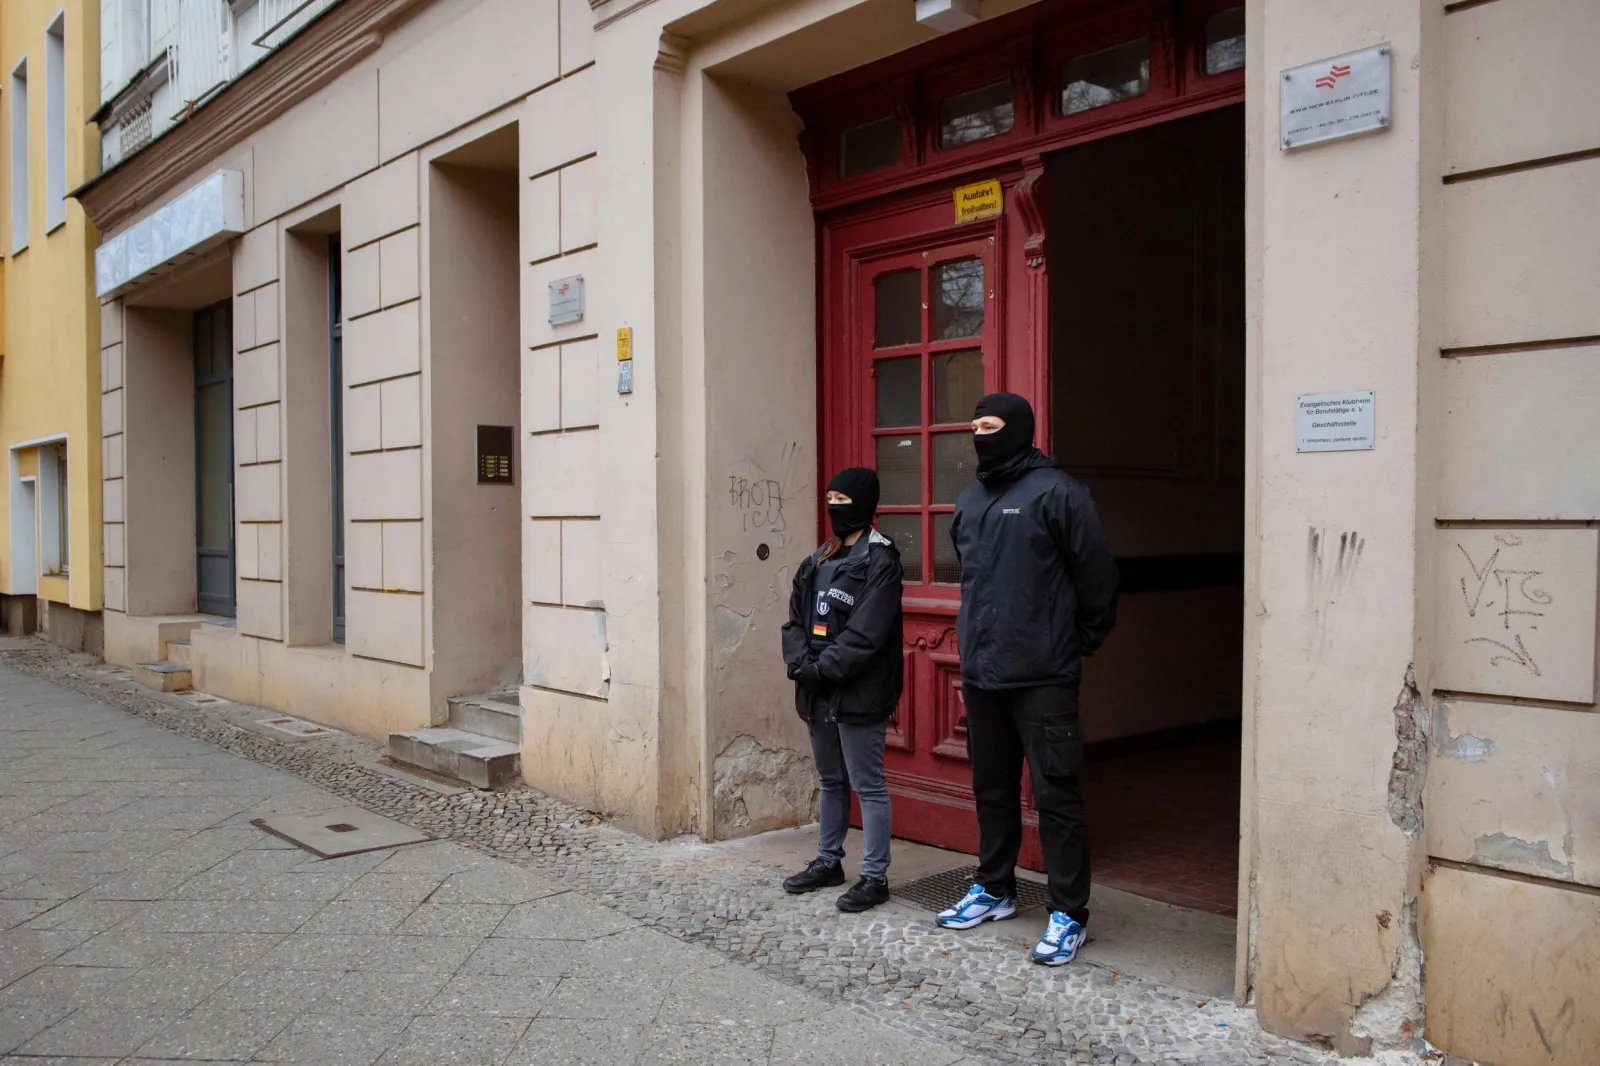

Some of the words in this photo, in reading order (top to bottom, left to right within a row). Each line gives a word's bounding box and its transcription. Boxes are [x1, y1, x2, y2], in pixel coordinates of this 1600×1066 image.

[963, 188, 994, 202] Ausfahrt
[961, 200, 997, 216] freihalten!
[1300, 400, 1341, 408] Evangelisches
[1312, 420, 1357, 428] Geschäftsstelle
[827, 591, 855, 606] POLIZEI
